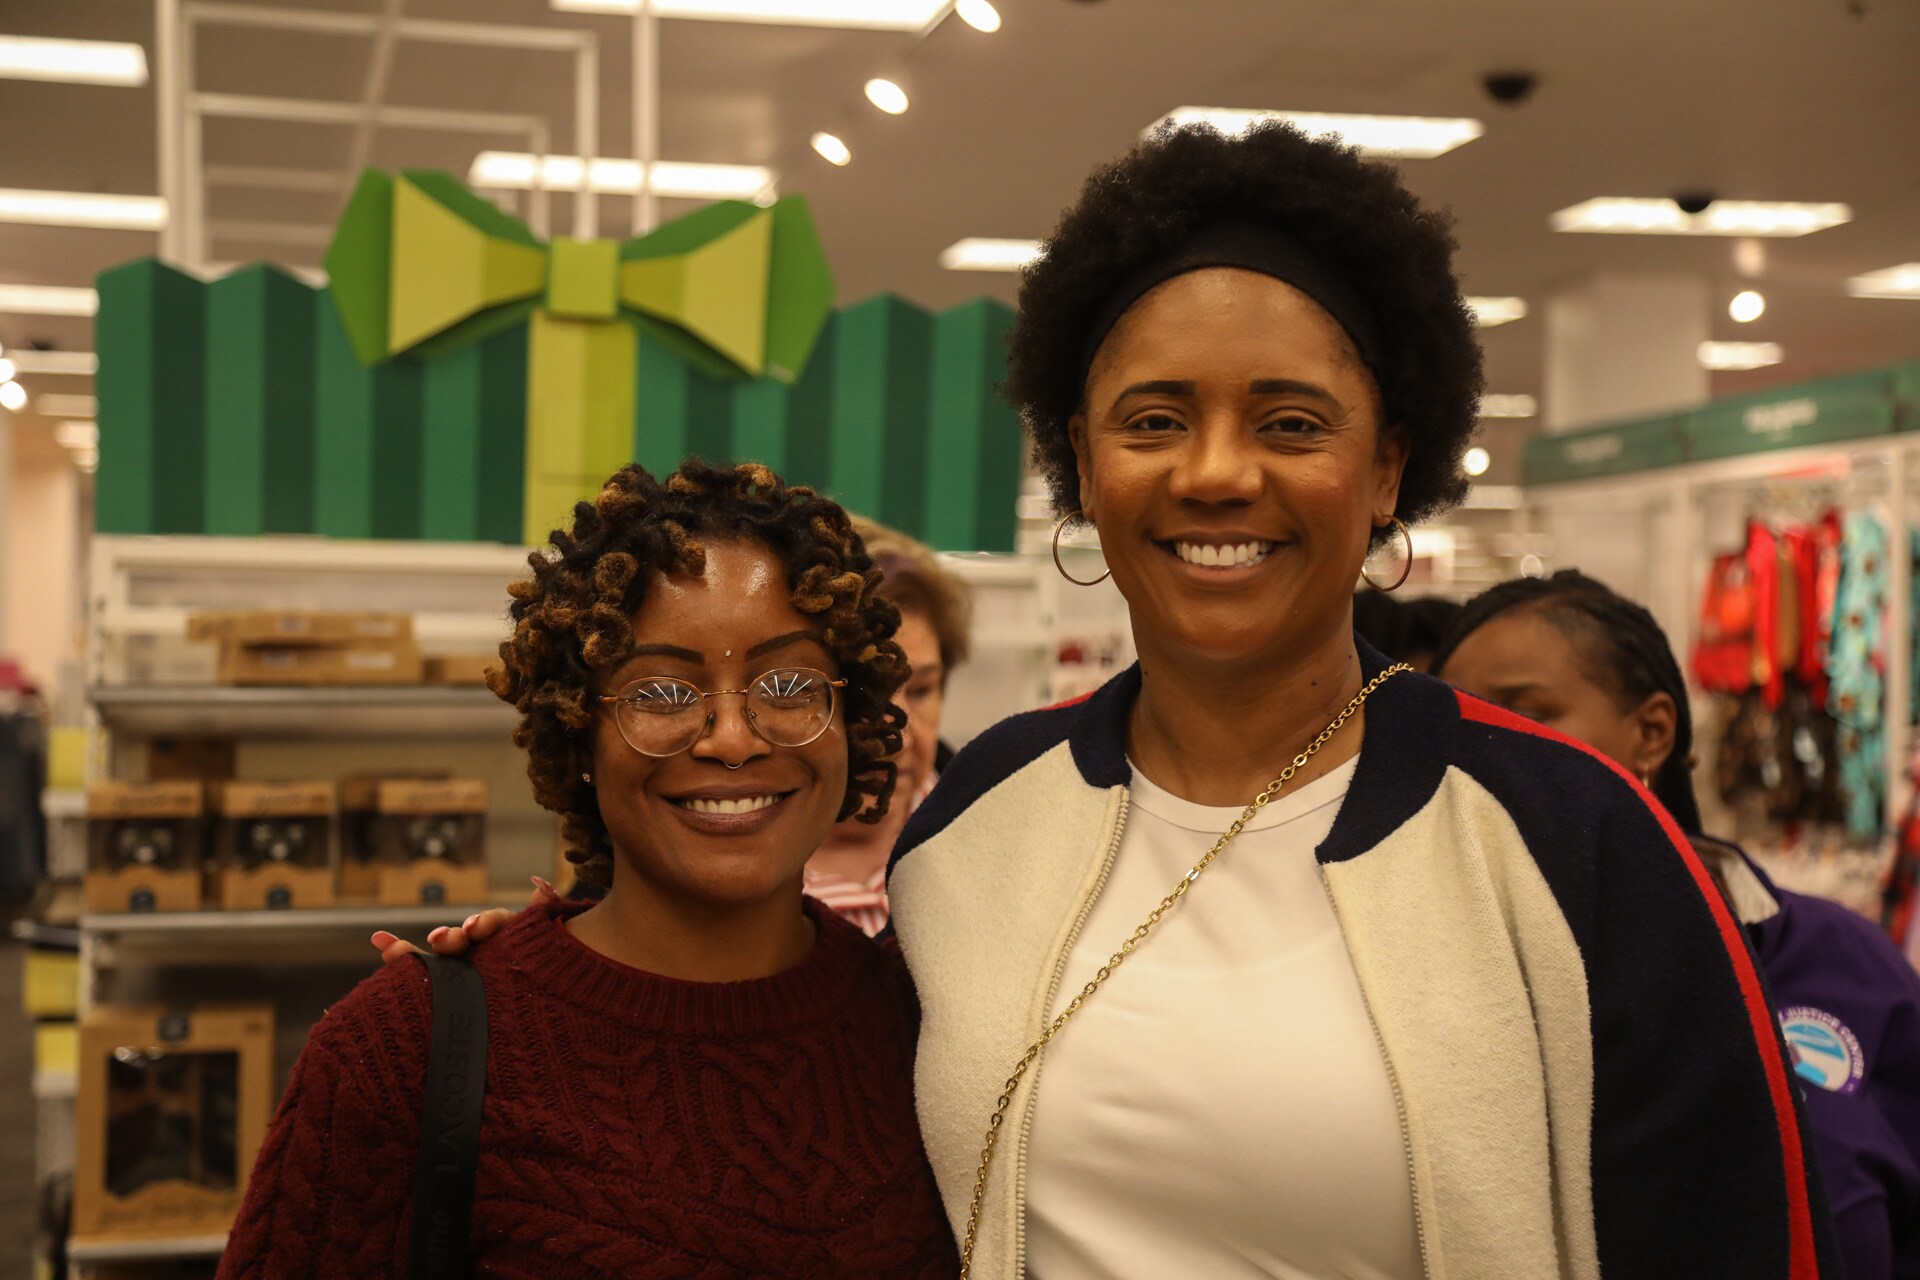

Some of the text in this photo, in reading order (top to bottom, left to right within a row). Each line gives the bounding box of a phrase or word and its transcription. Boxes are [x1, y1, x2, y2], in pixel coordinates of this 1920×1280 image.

[435, 1014, 471, 1172] LACOSTE
[1787, 1007, 1841, 1030] JUSTICE
[1841, 1026, 1864, 1079] CENTER
